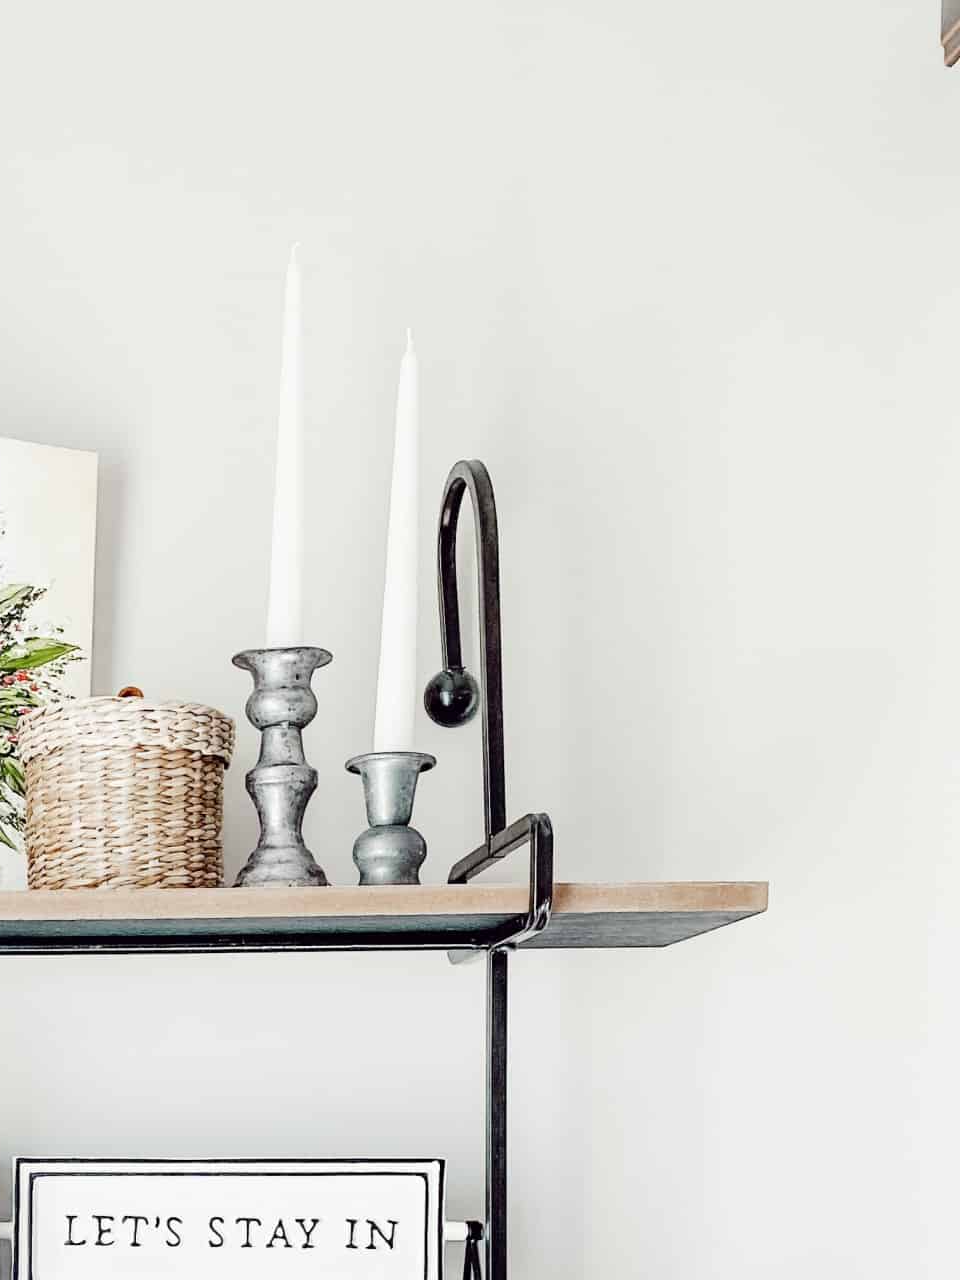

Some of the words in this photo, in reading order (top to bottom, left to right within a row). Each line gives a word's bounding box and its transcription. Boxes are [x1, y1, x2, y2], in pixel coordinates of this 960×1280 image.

[64, 1214, 183, 1248] LET'S
[208, 1215, 321, 1249] STAY
[345, 1217, 400, 1250] IN
